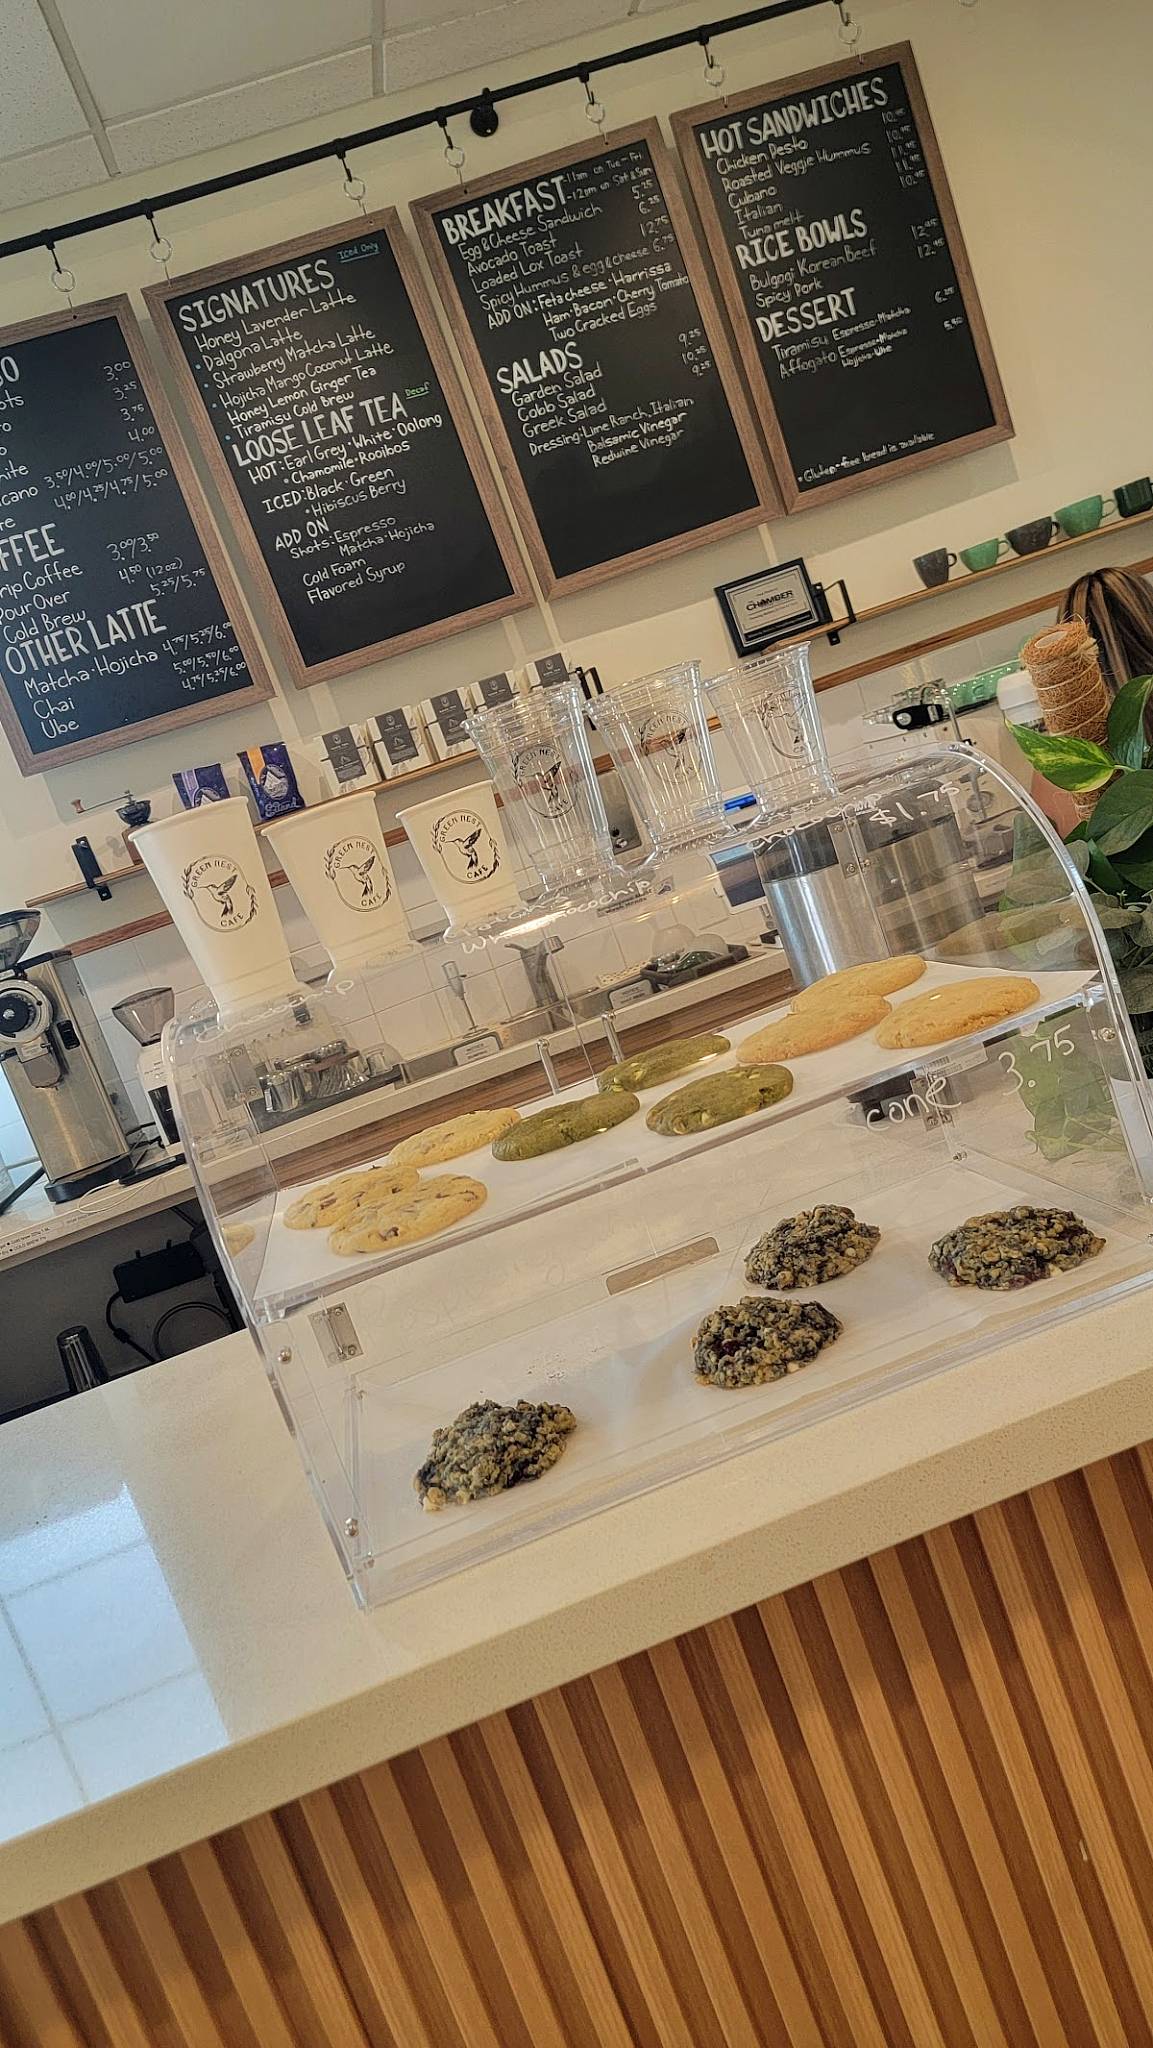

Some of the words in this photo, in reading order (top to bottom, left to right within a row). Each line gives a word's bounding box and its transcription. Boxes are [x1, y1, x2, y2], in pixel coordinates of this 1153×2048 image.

[700, 122, 743, 159] HOT
[747, 77, 888, 145] SANDWICHES
[717, 153, 767, 174] Chicken
[769, 136, 808, 159] Pesto
[722, 165, 773, 193] Roasted
[775, 157, 814, 176] Veggie
[815, 143, 870, 162] Hummus
[442, 175, 571, 244] BREAKFAST
[728, 187, 777, 209] Cubano
[734, 204, 781, 225] Italian
[537, 203, 603, 234] Sandwich
[468, 249, 518, 276] Avocado
[519, 231, 557, 257] Toast
[735, 230, 794, 269] RICE
[795, 209, 867, 252] BOWLS
[471, 265, 518, 293] Loaded
[519, 260, 544, 275] Lox
[544, 242, 583, 266] Toast
[750, 268, 794, 297] Bulgogi
[179, 259, 334, 331] SIGNATURES
[480, 292, 519, 317] Spicy
[513, 273, 569, 297] Hummus
[756, 284, 791, 308] Spicy
[794, 277, 822, 297] Pork
[194, 330, 242, 360] Honey
[241, 308, 308, 335] Lavender
[309, 289, 356, 313] Latte
[488, 309, 511, 329] ADD
[548, 327, 575, 341] Two
[575, 306, 625, 332] Cracked
[627, 294, 657, 318] Eggs
[756, 287, 856, 342] DESSERT
[202, 342, 260, 378] Dalgona
[260, 327, 303, 349] Latte
[213, 356, 286, 396] Strawberry
[285, 339, 336, 362] Matcha
[336, 324, 375, 347] Latte
[497, 342, 582, 393] SALADS
[219, 387, 270, 414] Hojicha
[265, 370, 306, 393] Mango
[305, 348, 352, 377] Coconut
[354, 343, 394, 361] Latte
[227, 404, 269, 429] Honey
[267, 385, 308, 408] Lemon
[311, 375, 351, 399] Ginger
[352, 365, 376, 380] Tea
[512, 384, 562, 407] Garden
[564, 362, 602, 388] Salad
[233, 412, 291, 438] Tiramisu
[293, 400, 318, 417] Cold
[320, 389, 354, 407] Brew
[518, 401, 556, 421] Cobb
[557, 383, 596, 408] Salad
[523, 415, 566, 437] Greek
[567, 398, 607, 423] Salad
[232, 424, 303, 466] LOOSE
[301, 405, 353, 444] LEAF
[359, 393, 408, 426] TEA
[314, 444, 347, 461] Grey
[369, 480, 406, 498] Berry
[276, 529, 301, 551] ADD
[307, 517, 329, 537] ON
[23, 561, 83, 590] Coffee
[303, 568, 329, 586] Cold
[330, 559, 366, 576] Foam
[307, 573, 363, 604] Flavored
[366, 563, 405, 582] Syrup
[33, 592, 70, 609] Over
[3, 617, 39, 643] Cold
[41, 611, 85, 632] Brew
[5, 627, 89, 674] OTHER
[87, 599, 167, 650] LATTE
[34, 698, 74, 719] Chai
[41, 719, 79, 738] Ube
[439, 817, 459, 843] GREEN
[460, 814, 482, 829] NEST
[191, 861, 213, 888] GREEN
[214, 860, 238, 874] NEST
[333, 843, 353, 869] GREEN
[354, 841, 375, 855] NEST
[466, 865, 489, 880] CAFE
[360, 893, 383, 907] CAFE
[220, 911, 244, 928] CAFE
[999, 1025, 1075, 1096] 3.75
